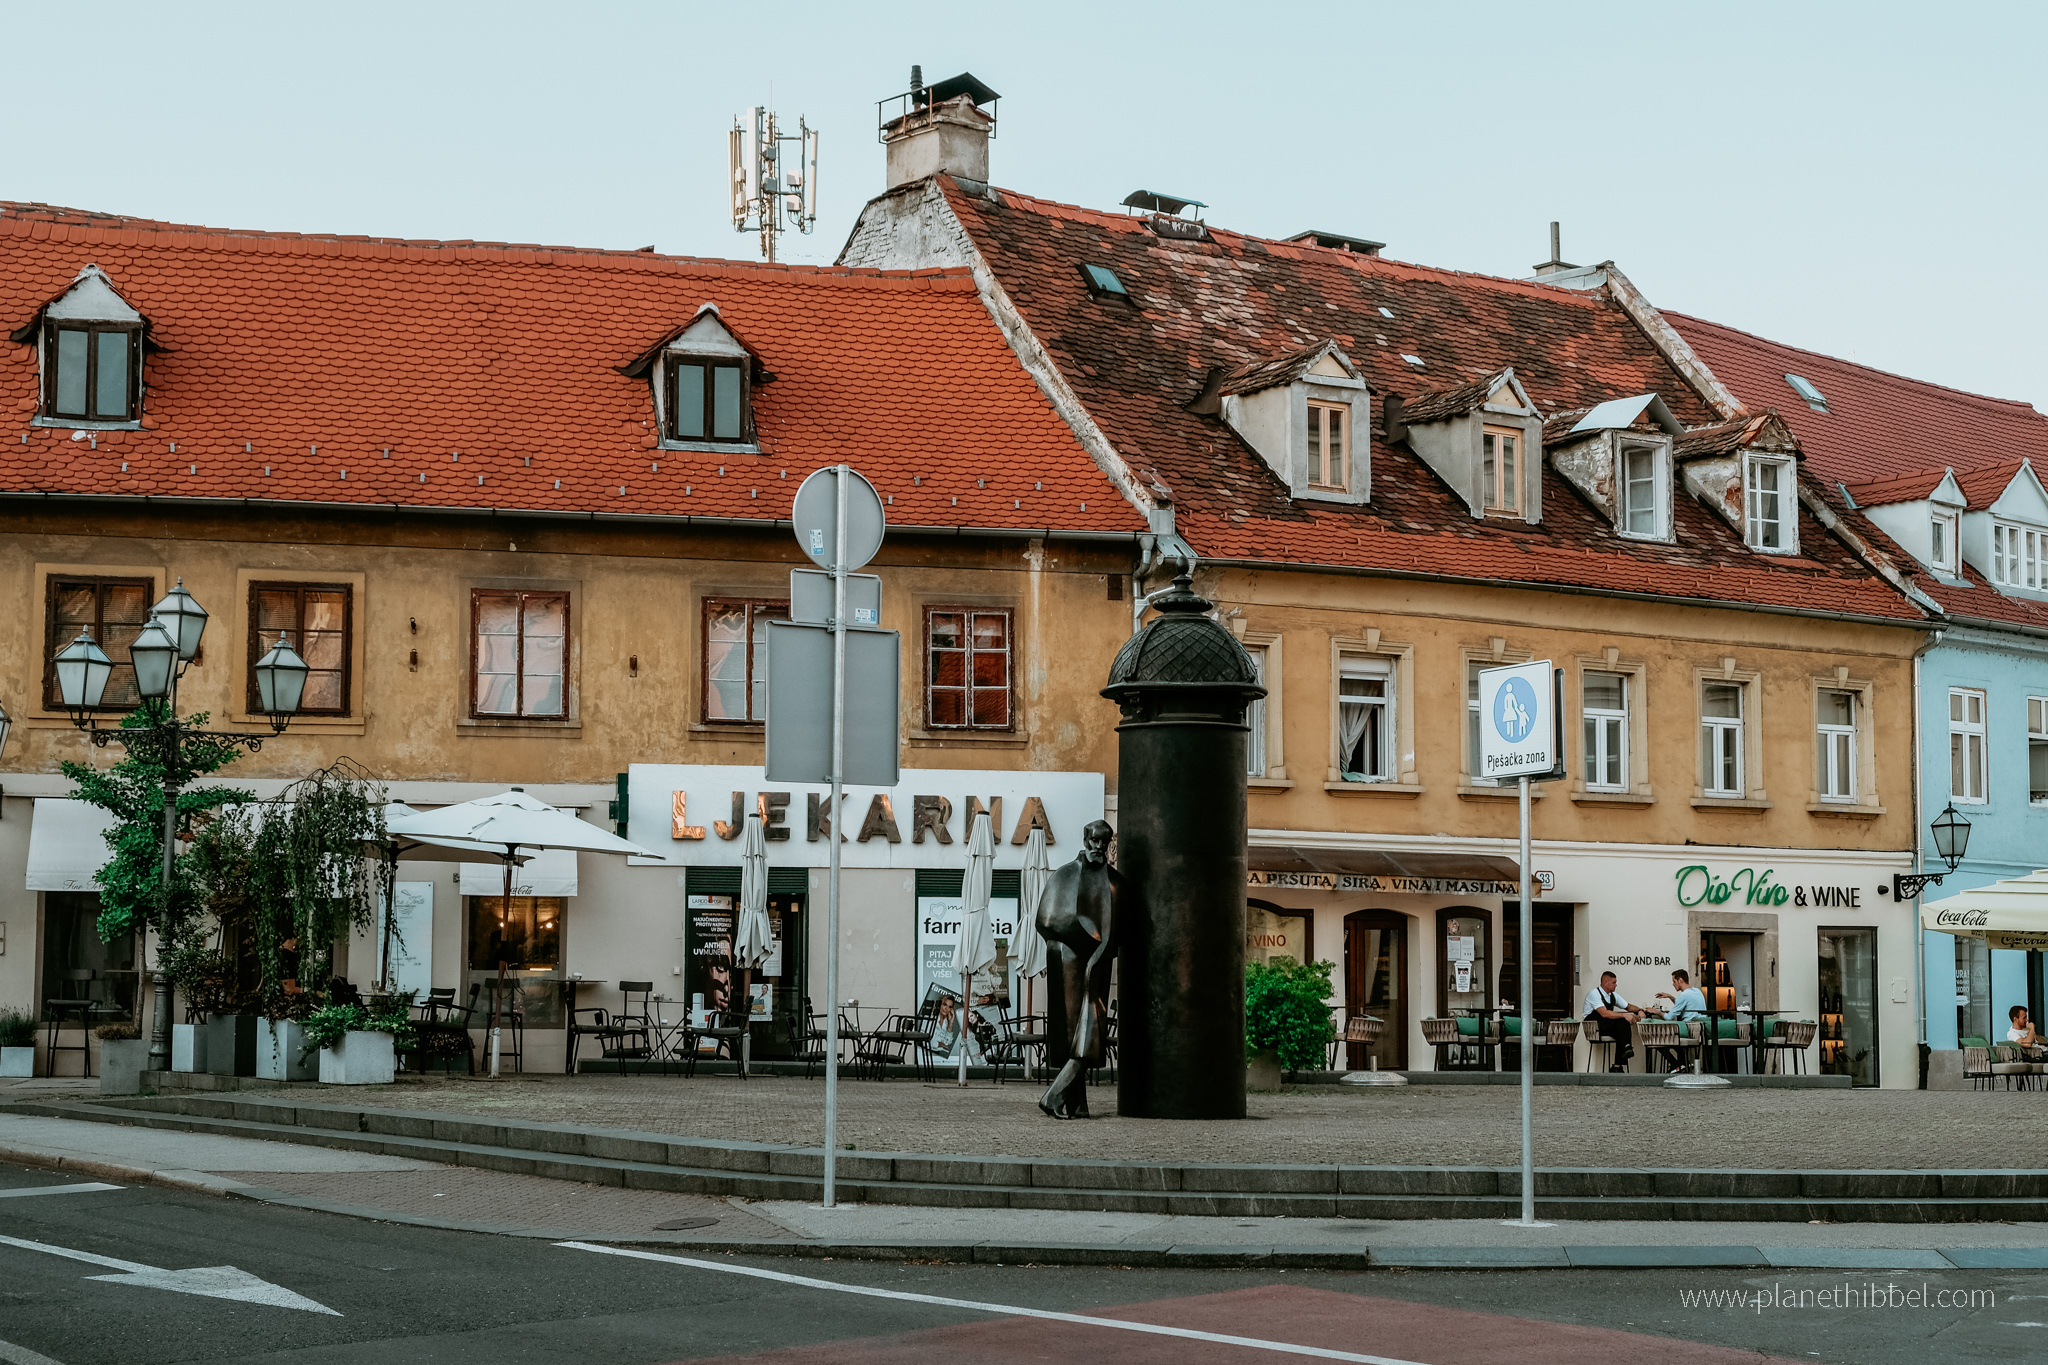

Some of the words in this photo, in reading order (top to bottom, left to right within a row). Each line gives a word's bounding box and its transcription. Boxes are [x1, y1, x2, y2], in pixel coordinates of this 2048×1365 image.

[1488, 752, 1523, 771] Pješačka
[1526, 751, 1545, 763] zona
[672, 790, 1056, 845] LJEKARNA
[1247, 872, 1261, 883] A
[1267, 871, 1337, 888] PRŠUTA,
[1342, 876, 1386, 890] SIRA,
[1391, 878, 1431, 891] VINA
[1436, 880, 1441, 891] I
[1446, 881, 1518, 894] MASLINA
[1540, 873, 1550, 884] 33
[1731, 868, 1790, 906] Vivo
[1794, 885, 1809, 907] &
[1811, 886, 1861, 908] WINE
[1936, 909, 1990, 926] Coca-Cola
[923, 918, 1012, 935] faria
[1253, 935, 1286, 947] VINO
[926, 959, 953, 968] OČEKU
[1608, 956, 1631, 965] SHOP
[1634, 956, 1652, 965] AND
[1655, 956, 1671, 965] BAR
